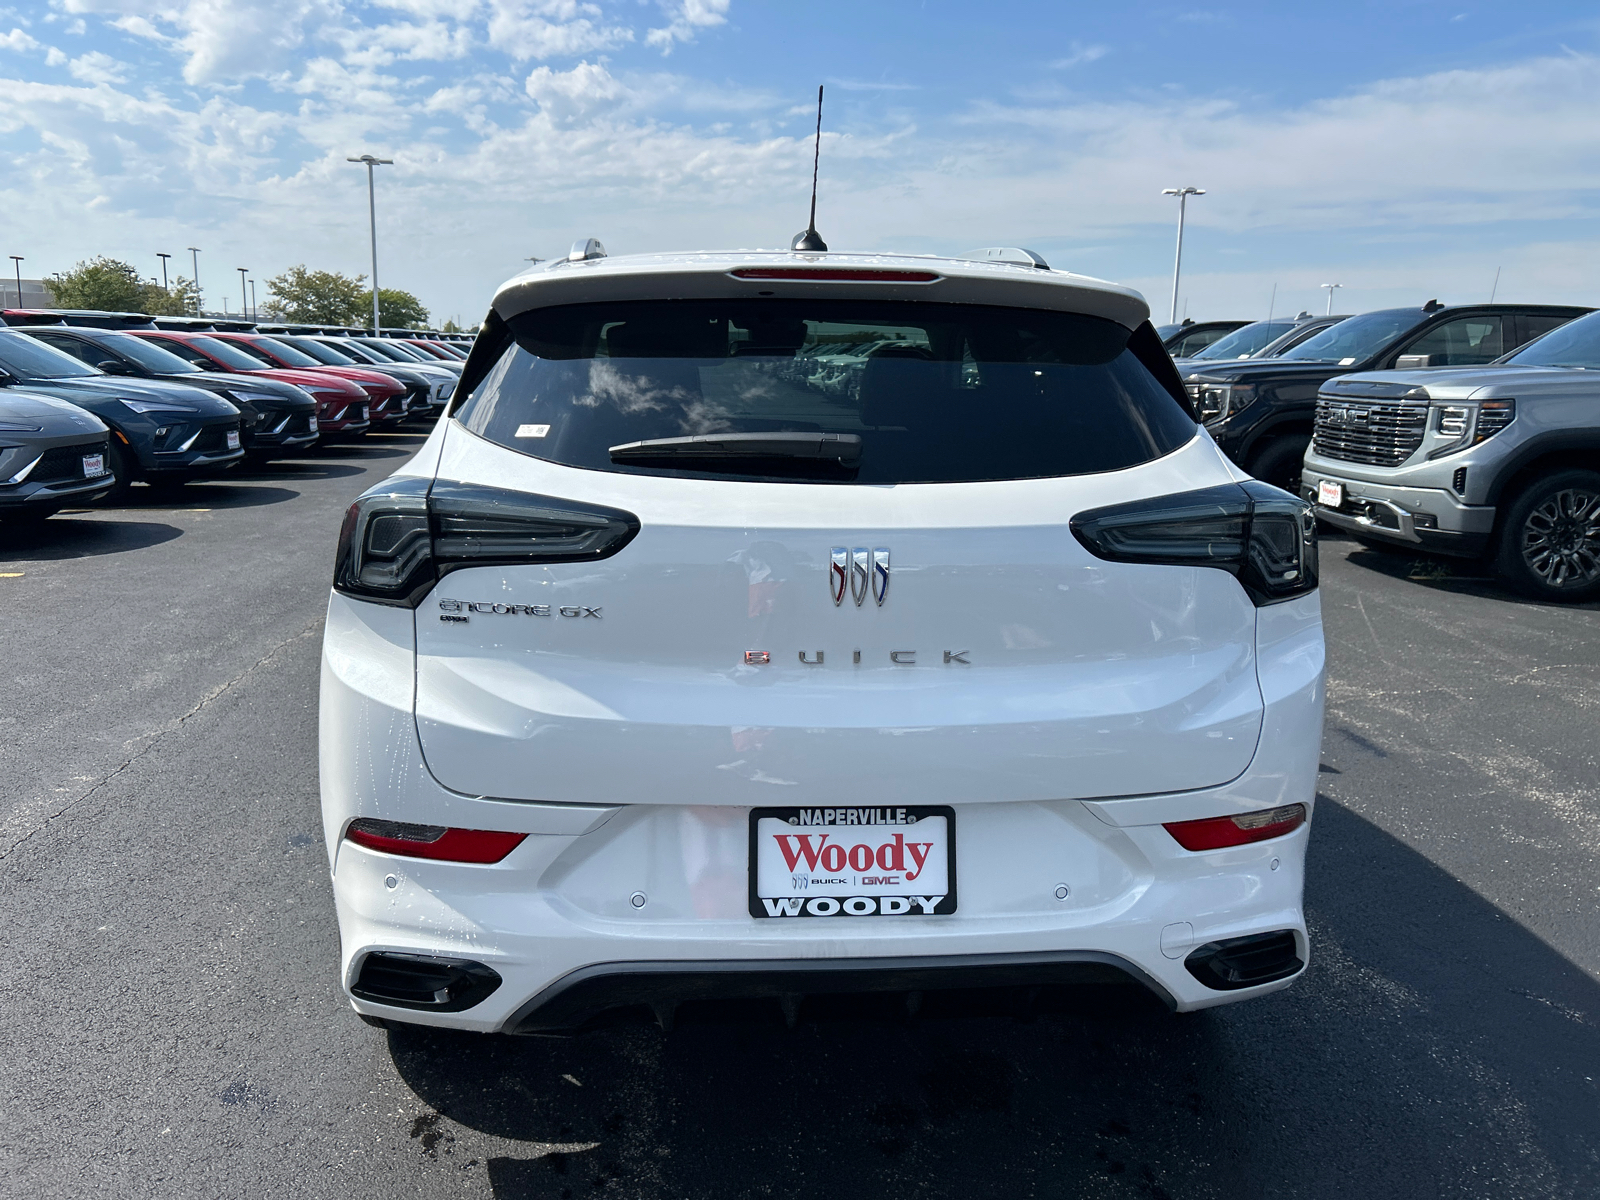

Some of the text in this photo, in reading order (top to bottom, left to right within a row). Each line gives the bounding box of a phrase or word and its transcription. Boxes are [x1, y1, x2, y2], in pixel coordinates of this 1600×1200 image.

[84, 459, 101, 469] Woody
[559, 605, 603, 619] GX
[744, 650, 971, 664] BUICK
[799, 808, 907, 826] NAPERVILLE
[772, 833, 934, 881] Woody
[861, 875, 900, 886] GMC
[761, 895, 946, 917] WOODY
